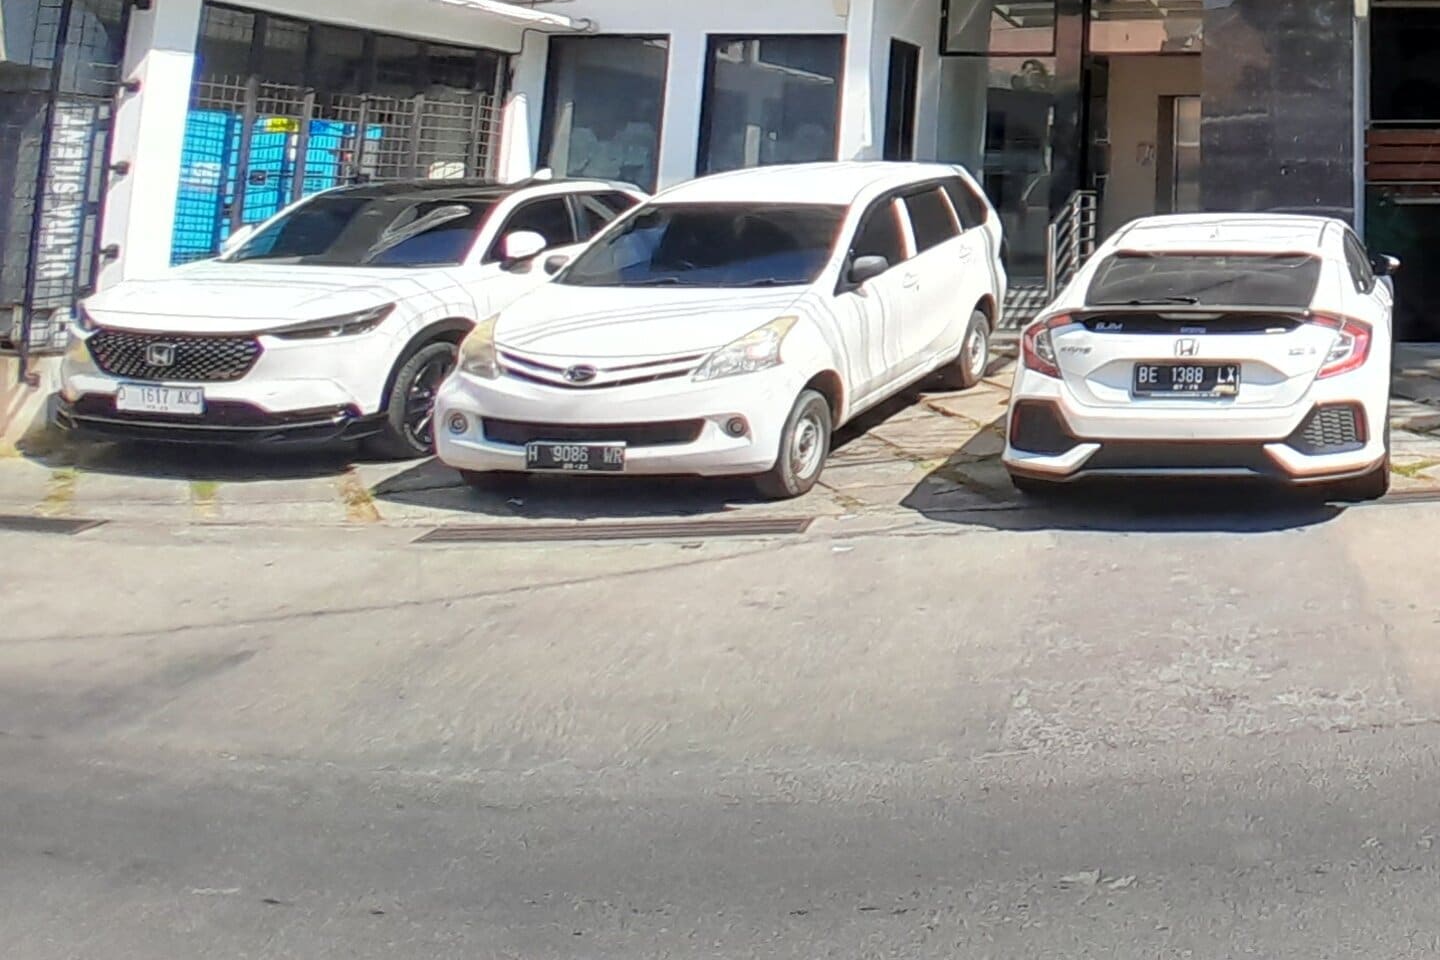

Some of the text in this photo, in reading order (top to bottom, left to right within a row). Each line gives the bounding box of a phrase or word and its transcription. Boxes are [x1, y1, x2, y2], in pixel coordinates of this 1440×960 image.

[1138, 366, 1236, 384] BE 1388 LX
[528, 445, 538, 462] H
